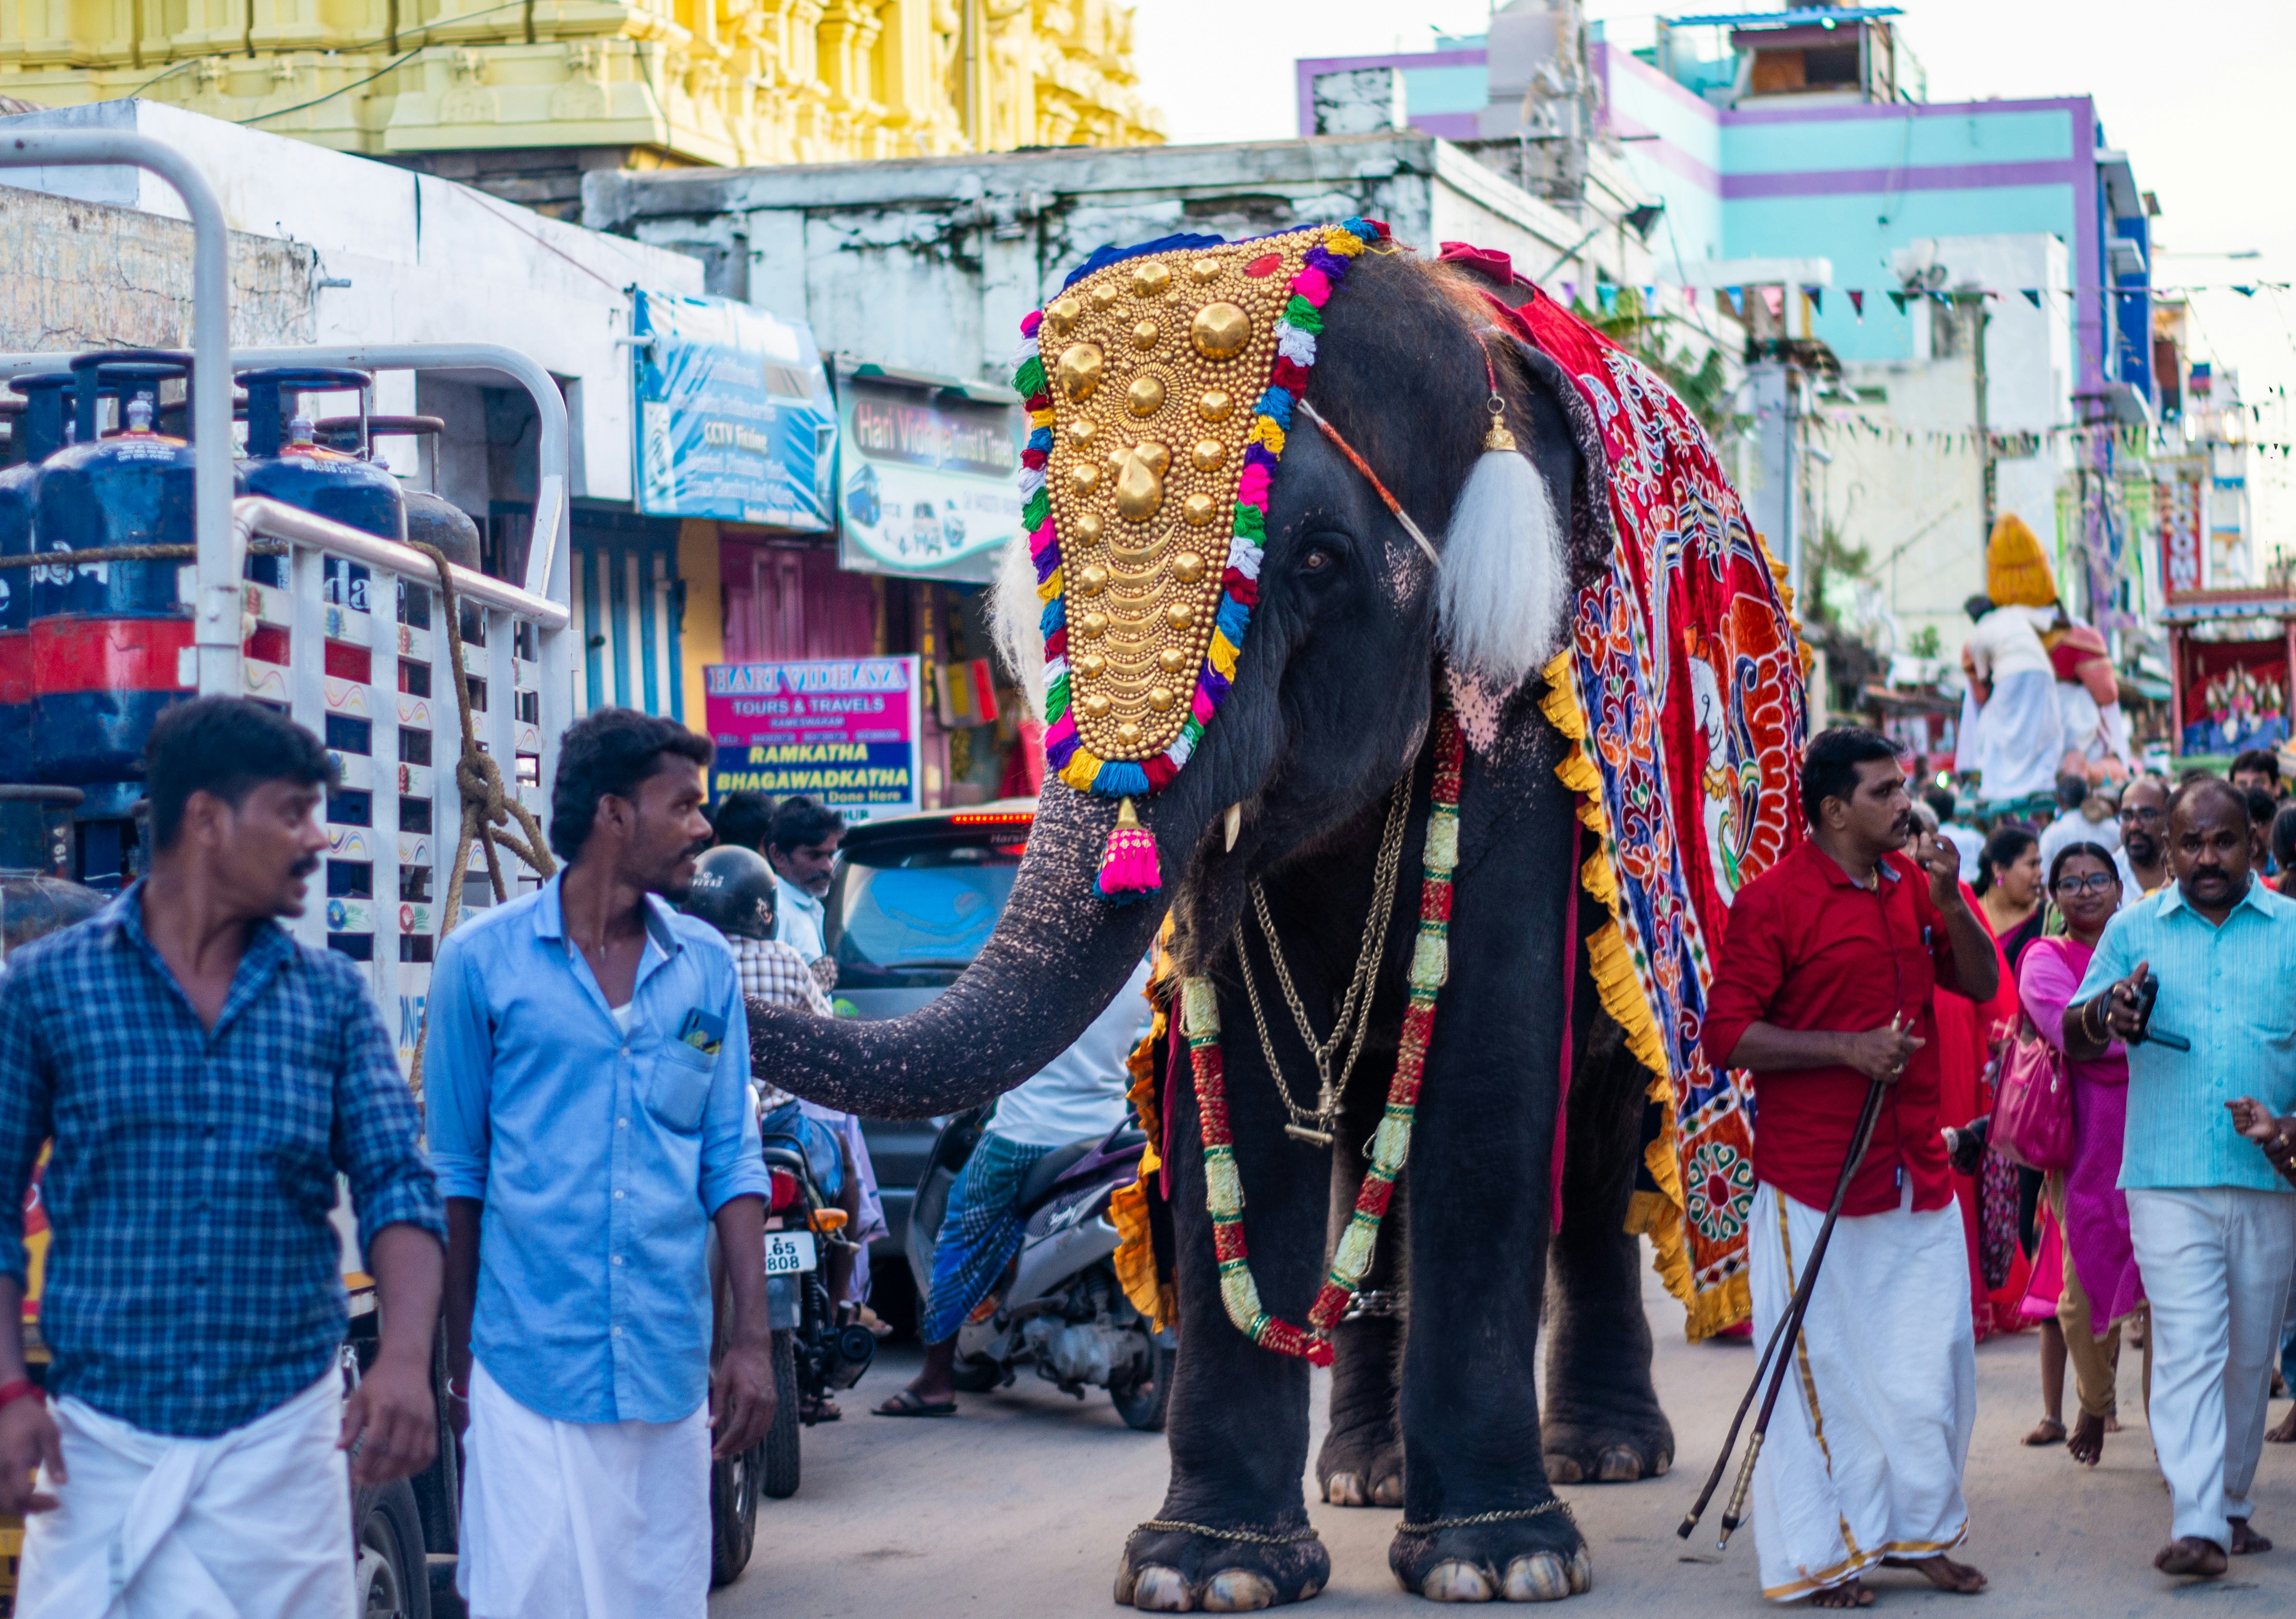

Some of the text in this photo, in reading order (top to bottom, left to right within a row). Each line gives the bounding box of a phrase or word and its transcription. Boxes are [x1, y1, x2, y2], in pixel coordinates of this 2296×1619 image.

[704, 422, 734, 445] CCTV
[859, 404, 894, 450] Hari
[712, 662, 907, 693] HARI VIDHAYA
[733, 696, 885, 715] TOURS & TRAVELS
[771, 717, 845, 728] RAMESWARAM
[749, 743, 868, 764] RAMKATHA
[716, 768, 909, 791] BHAGAWADKATHA
[828, 791, 865, 803] Done
[868, 790, 901, 802] Here
